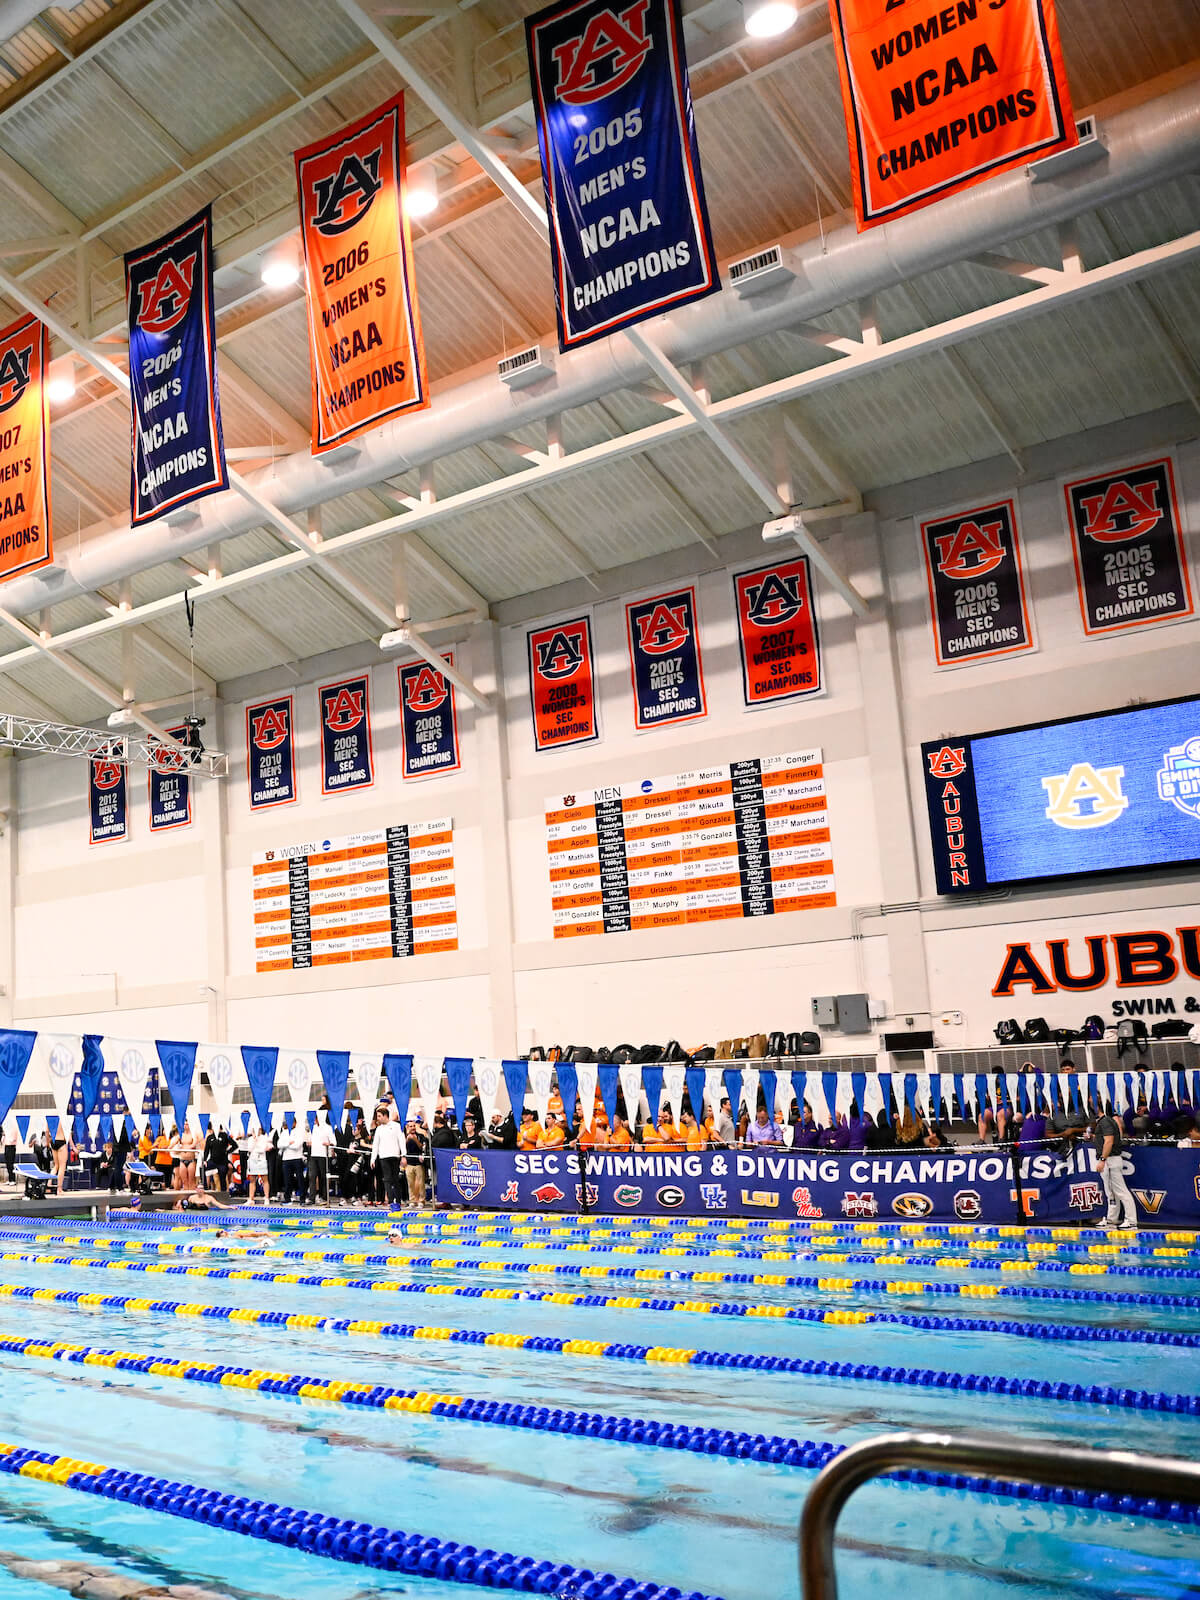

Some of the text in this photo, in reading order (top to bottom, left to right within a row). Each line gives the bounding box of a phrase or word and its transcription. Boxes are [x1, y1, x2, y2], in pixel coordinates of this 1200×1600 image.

[870, 0, 1007, 71] WOMEN
[890, 43, 999, 121] NCAA
[573, 108, 643, 164] 2005
[876, 89, 1037, 181] CHAMPIONS
[579, 156, 647, 207] MEN'S
[581, 199, 661, 258] NCAA
[322, 241, 369, 286] 2006
[573, 240, 691, 312] CHAMPIONS
[330, 321, 383, 371] NCAA
[143, 377, 182, 414] MEN'S
[142, 411, 189, 456] NCAA
[141, 447, 207, 497] CAMPIONS
[1103, 545, 1152, 571] 2005
[1106, 562, 1155, 586] MEN'S
[954, 581, 998, 605] 2006
[1118, 581, 1148, 599] SEC
[957, 597, 1000, 620] MEN'S
[1096, 591, 1177, 621] CHAMPIONS
[967, 615, 994, 633] SEC
[760, 630, 795, 650] 2007
[948, 626, 1018, 653] CHAMPIONS
[753, 644, 808, 666] WOMEN'S
[650, 657, 683, 677] 2007
[770, 661, 792, 676] SEC
[650, 672, 685, 690] MEN'S
[754, 672, 812, 695] CHAMPIONS
[548, 684, 578, 702] 2008
[659, 687, 679, 700] SEC
[541, 696, 586, 715] WOMEN'S
[643, 698, 697, 719] CHAMPIONS
[415, 715, 442, 731] 2008
[556, 711, 573, 725] SEC
[416, 728, 443, 744] MEN'S
[541, 722, 589, 741] CHAMPIONS
[334, 735, 358, 751] 2009
[421, 742, 438, 755] SEC
[260, 753, 282, 767] 2010
[334, 747, 358, 762] MEN'S
[410, 751, 451, 769] CHAMPIONS
[786, 754, 815, 764] Conger
[260, 765, 282, 779] MEN'S
[339, 760, 354, 772] SEC
[265, 777, 279, 788] SEC
[328, 769, 366, 786] CHAMPIONS
[699, 771, 722, 779] Morris
[785, 769, 818, 780] Finnerty
[160, 779, 179, 792] 2011
[254, 785, 289, 802] CHAMPIONS
[595, 787, 621, 800] MEN
[698, 787, 723, 795] Mikuta
[787, 784, 822, 796] Marchand
[1179, 779, 1200, 795] DI
[99, 793, 117, 806] 2012
[164, 801, 176, 811] SEC
[644, 795, 671, 805] Dressel
[699, 802, 724, 810] Mikuta
[789, 800, 824, 811] Marchand
[103, 815, 114, 825] SEC
[154, 809, 186, 824] CHAMPIONS
[645, 810, 672, 819] Dressel
[700, 816, 731, 825] Gonzalez
[790, 816, 825, 827] Marchand
[93, 823, 125, 837] CHAMPIONS
[701, 832, 732, 840] Gonzalez
[942, 781, 970, 887] AUBURN
[280, 843, 316, 858] WOMEN
[651, 840, 671, 848] Smith
[653, 901, 679, 909] Murphy
[1112, 998, 1176, 1016] SWIM
[514, 1154, 560, 1174] SEC
[566, 1153, 702, 1177] SWIMMING
[710, 1154, 728, 1176] &
[736, 1155, 840, 1182] DIVING
[459, 1176, 484, 1185] DIVING
[741, 1189, 780, 1208] LSU
[792, 1187, 810, 1203] Ole
[797, 1201, 823, 1217] Miss
